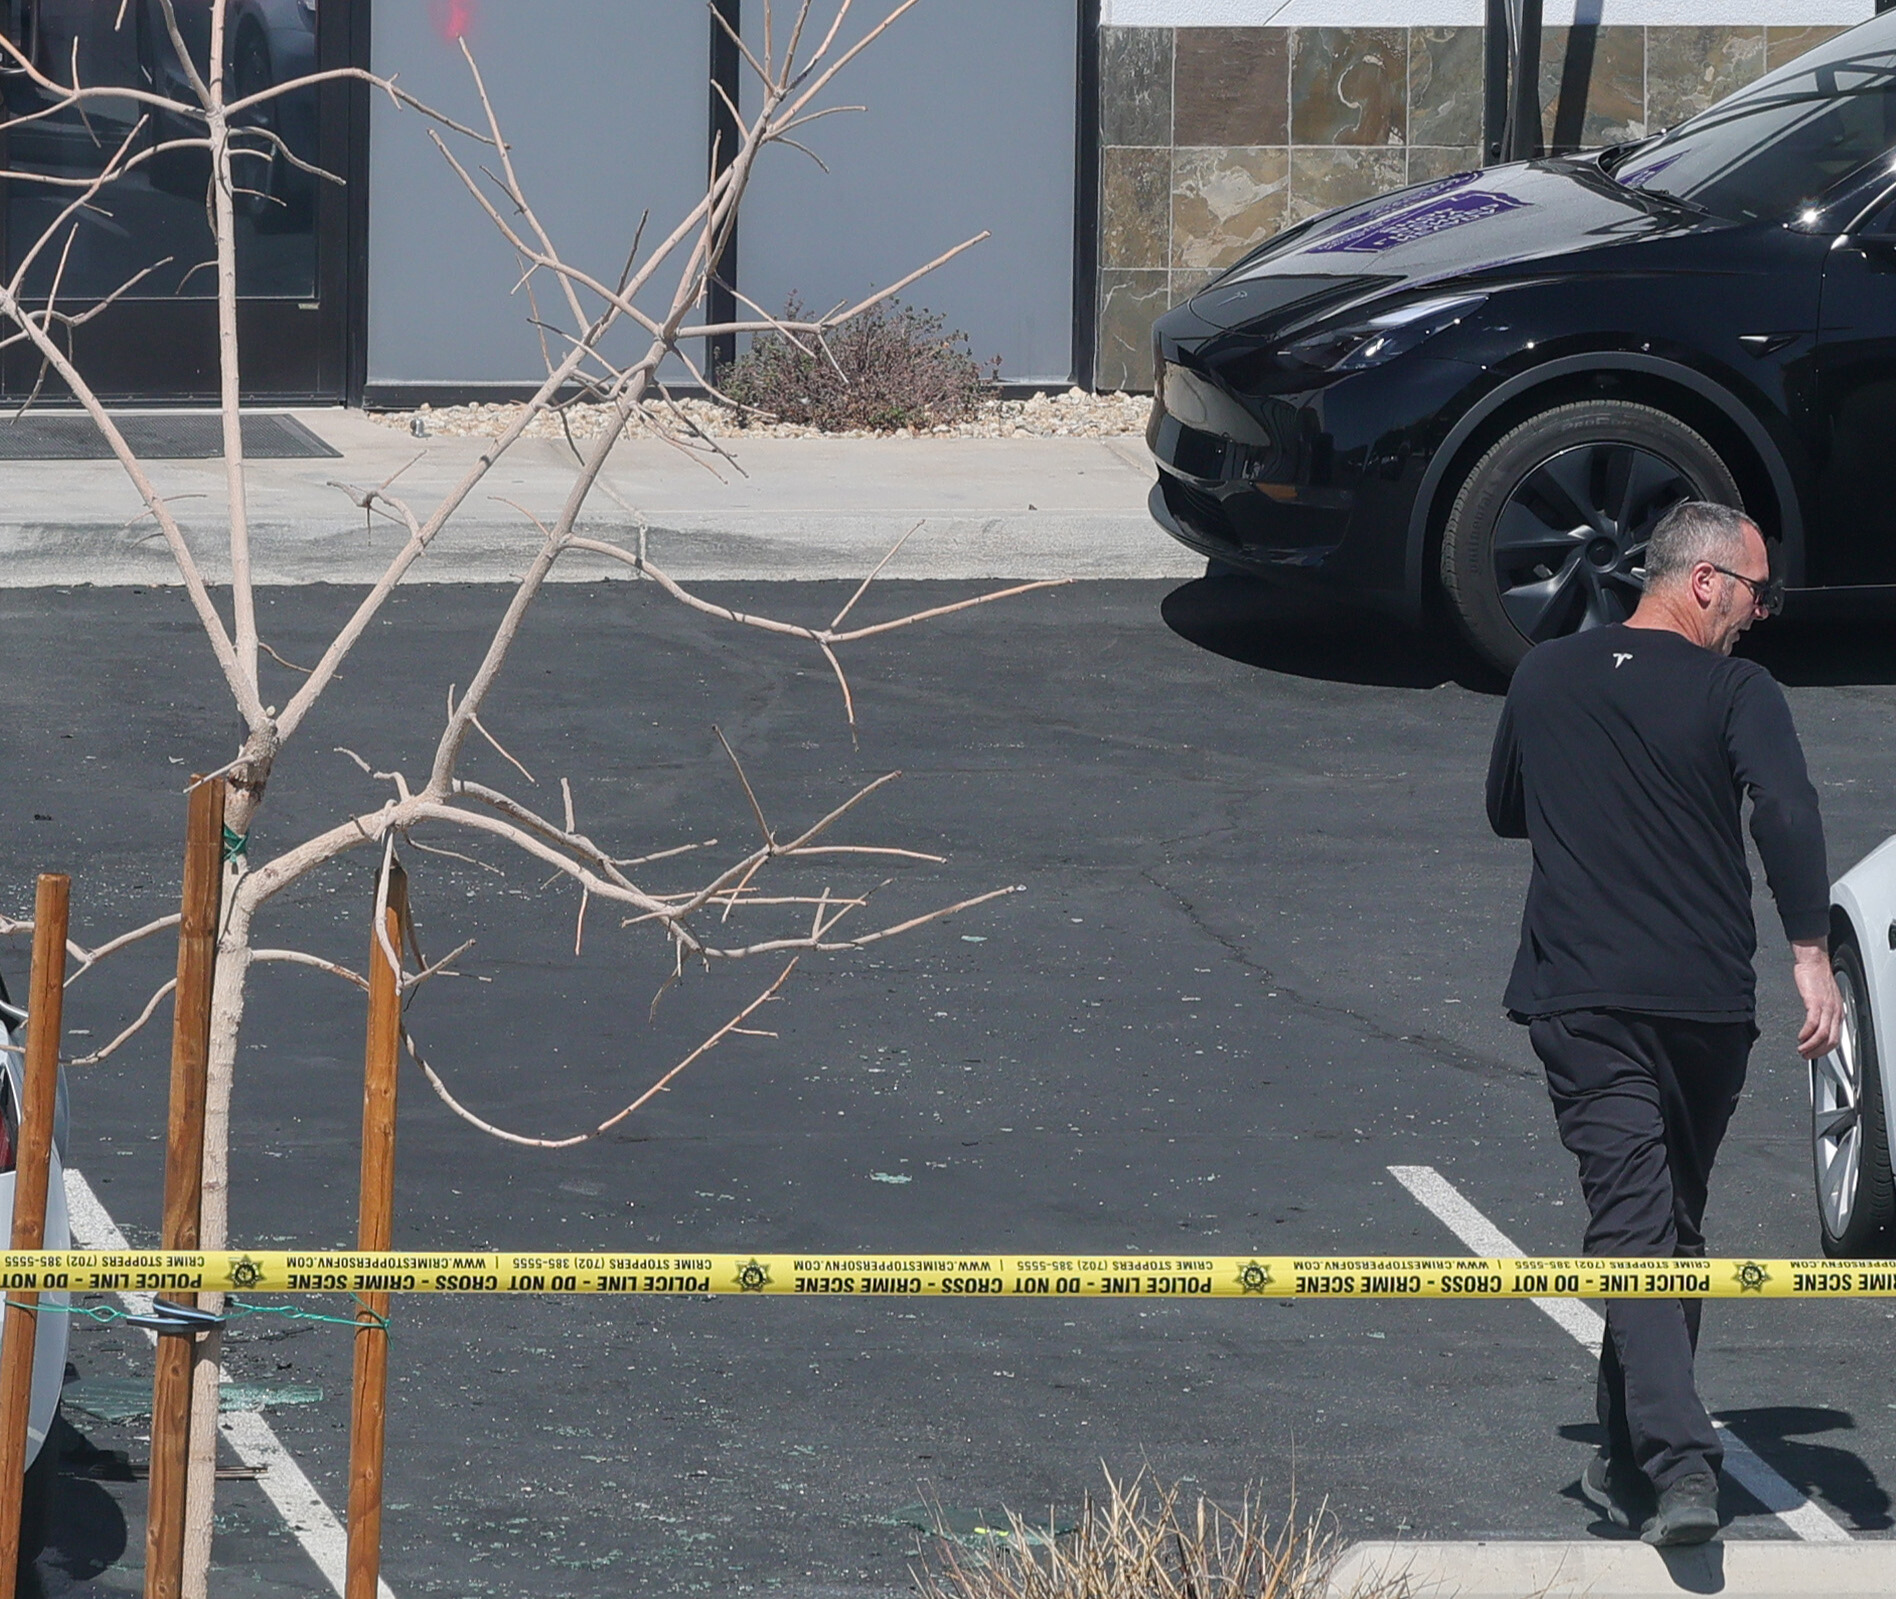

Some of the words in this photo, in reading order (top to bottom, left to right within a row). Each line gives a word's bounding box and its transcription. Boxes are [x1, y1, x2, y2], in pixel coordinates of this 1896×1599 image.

[794, 1261, 991, 1271] WWW.CRIMESTOPPERSOFNV.COM
[1017, 1262, 1073, 1271] 385-5555
[1078, 1262, 1107, 1271] (702)
[1112, 1262, 1171, 1271] STOPPERS
[1176, 1262, 1213, 1270] CRIME
[0, 1274, 37, 1288] NOT
[43, 1274, 68, 1288] DO
[89, 1274, 129, 1288] LINE
[135, 1275, 202, 1288] POLICE
[287, 1275, 348, 1290] SCENE
[353, 1275, 415, 1290] CRIME
[435, 1276, 497, 1290] CROSS
[507, 1276, 545, 1290] NOT
[551, 1276, 576, 1291] DO
[596, 1276, 637, 1291] LINE
[643, 1276, 710, 1291] POLICE
[795, 1277, 855, 1291] SCENE
[860, 1278, 921, 1291] CRIME
[941, 1278, 1003, 1291] CROSS
[1013, 1277, 1049, 1291] NOT
[1056, 1277, 1081, 1291] DO
[1101, 1277, 1140, 1291] LINE
[1147, 1277, 1211, 1291] POLICE
[1295, 1276, 1354, 1291] SCENE
[1360, 1276, 1421, 1291] CRIME
[1441, 1275, 1502, 1291] CROSS
[1511, 1275, 1548, 1291] NOT
[1554, 1275, 1579, 1291] DO
[1599, 1275, 1638, 1291] LINE
[1645, 1274, 1710, 1291] POLICE
[1793, 1274, 1852, 1291] SCENE
